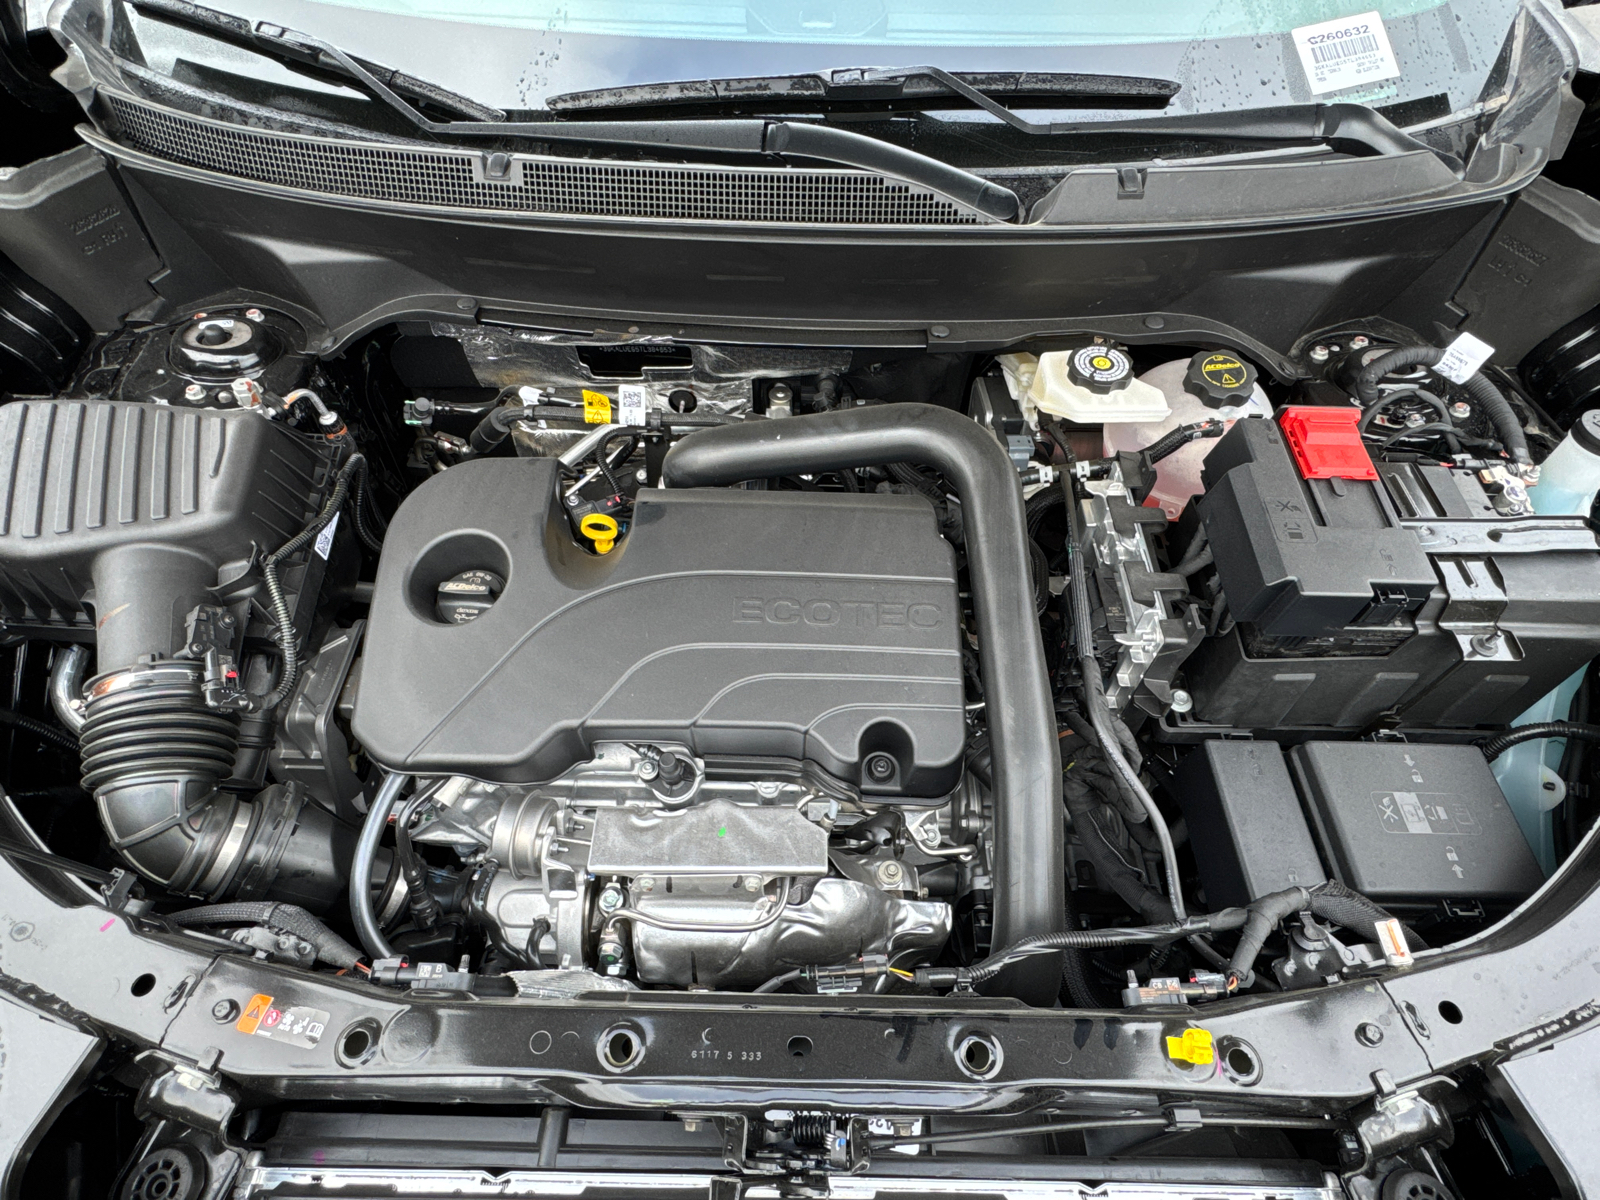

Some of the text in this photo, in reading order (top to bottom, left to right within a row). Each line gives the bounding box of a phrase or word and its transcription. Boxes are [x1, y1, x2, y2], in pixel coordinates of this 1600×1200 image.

[1205, 362, 1240, 371] ACDelco
[444, 582, 486, 591] ACDelco
[732, 596, 943, 630] ECOTEC
